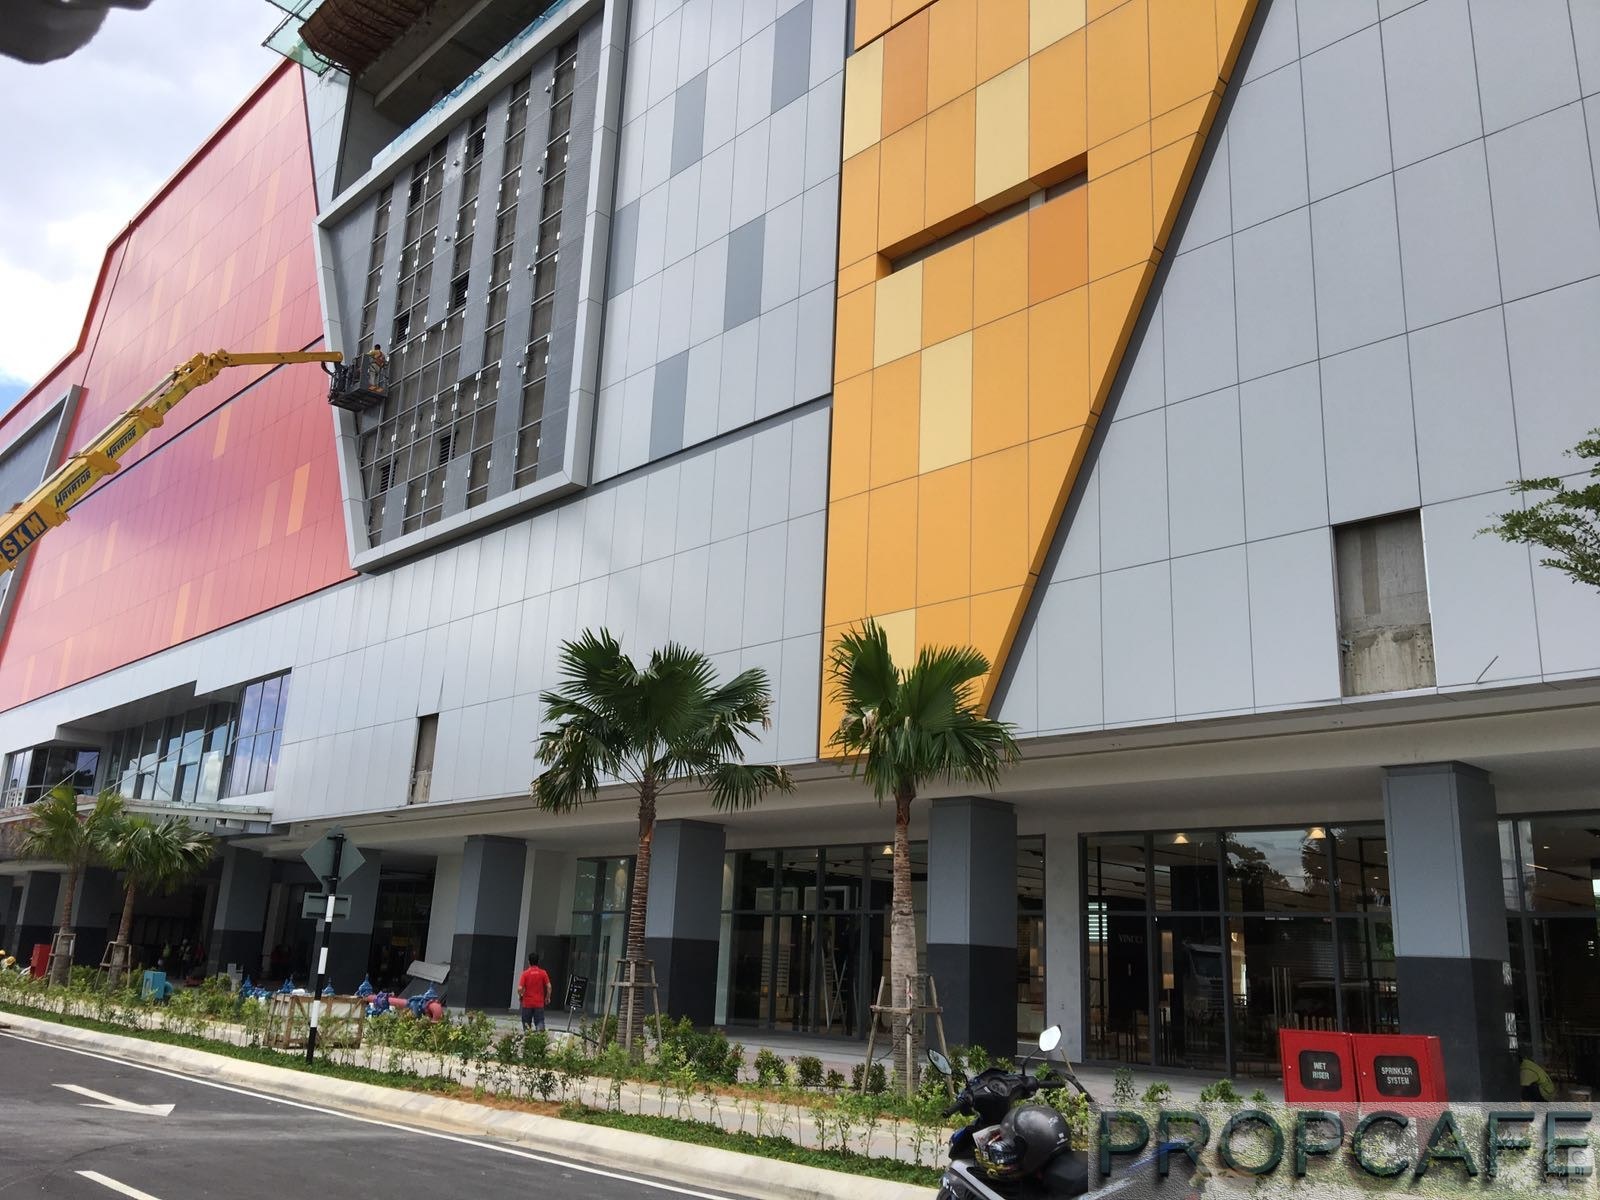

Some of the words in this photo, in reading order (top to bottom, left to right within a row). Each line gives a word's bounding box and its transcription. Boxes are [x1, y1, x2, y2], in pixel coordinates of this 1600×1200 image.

[105, 424, 137, 459] HAVATOR
[54, 467, 92, 508] HAVATOR
[1, 514, 44, 559] SKM
[1313, 1062, 1327, 1071] WET
[1381, 1066, 1413, 1076] SPRINKLER
[1312, 1071, 1330, 1080] RISER
[1386, 1076, 1410, 1085] SYSTEM
